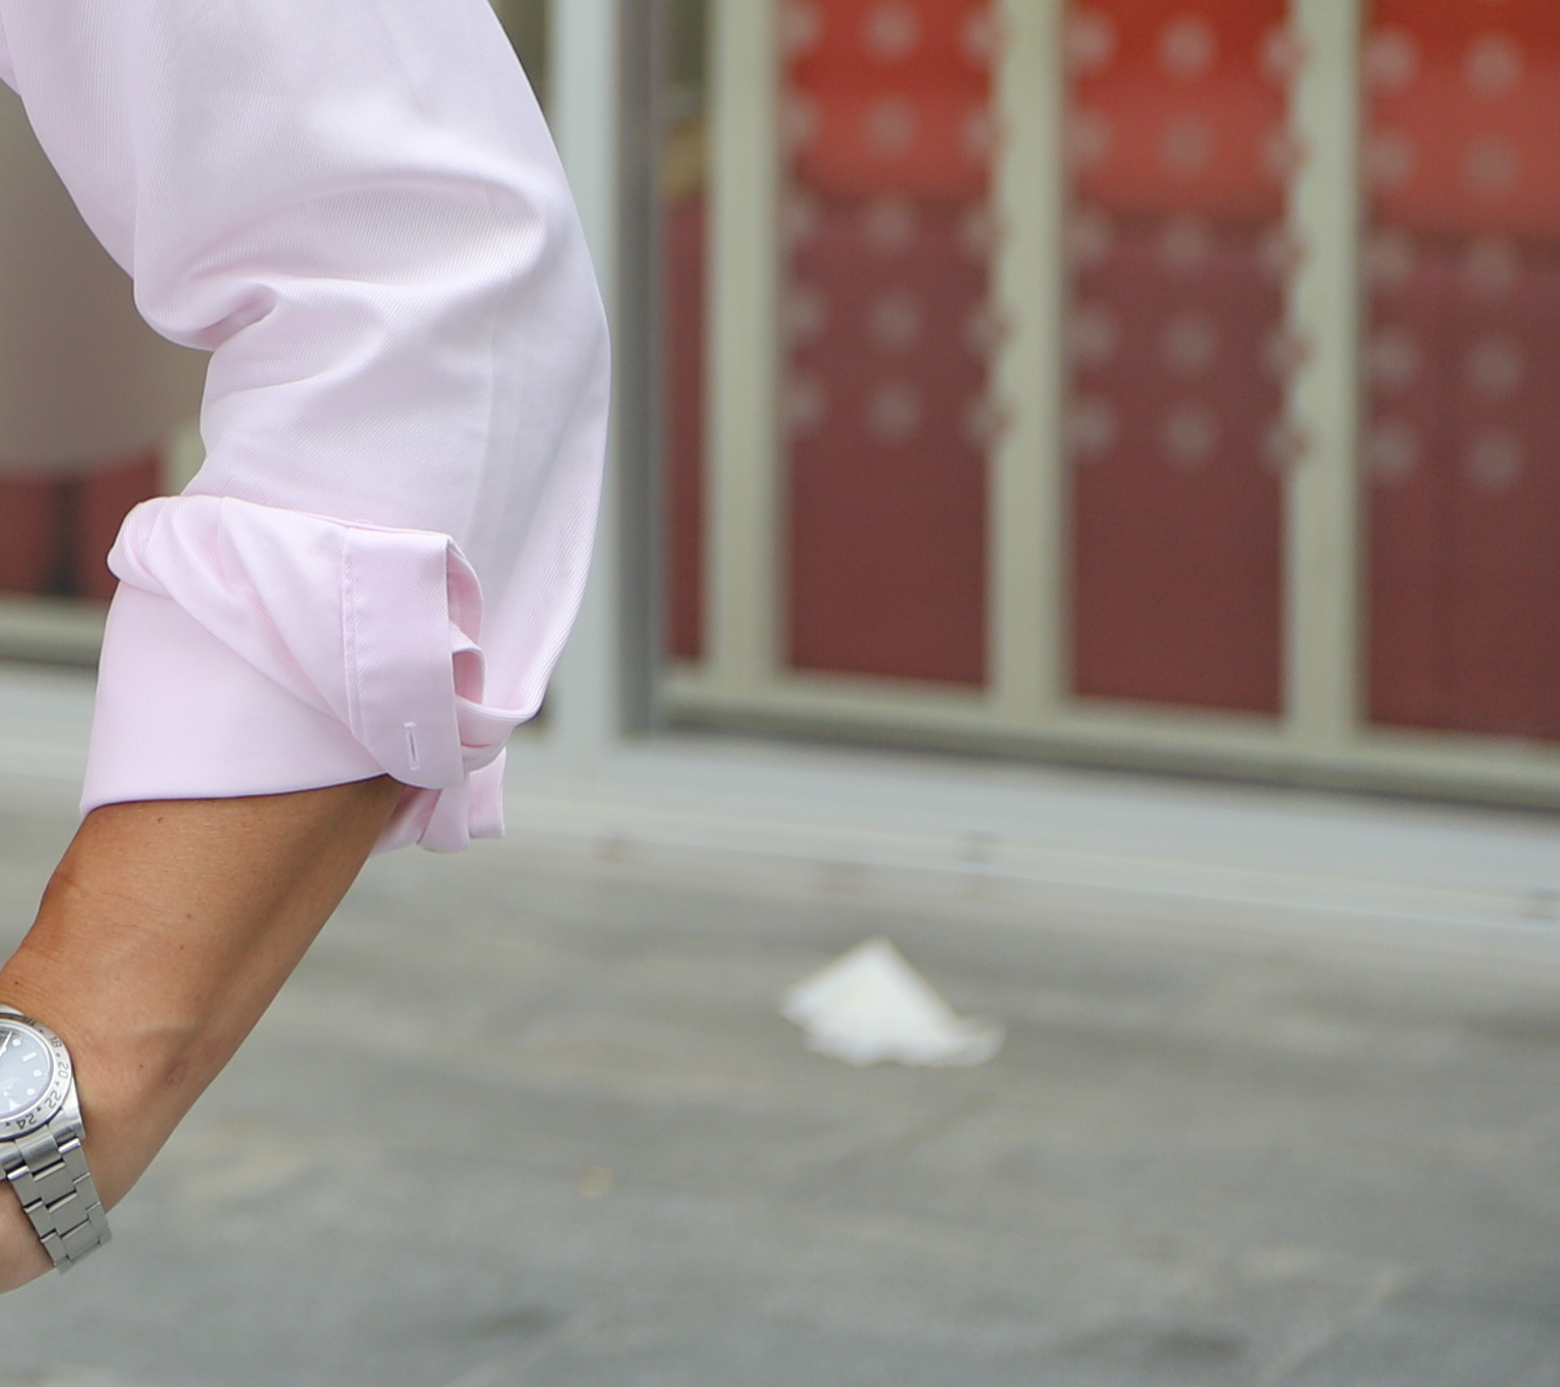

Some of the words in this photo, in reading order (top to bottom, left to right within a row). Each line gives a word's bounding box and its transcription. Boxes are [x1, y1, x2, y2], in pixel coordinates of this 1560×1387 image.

[57, 1061, 69, 1079] 20
[43, 1090, 62, 1109] 22
[16, 1113, 38, 1130] 24
